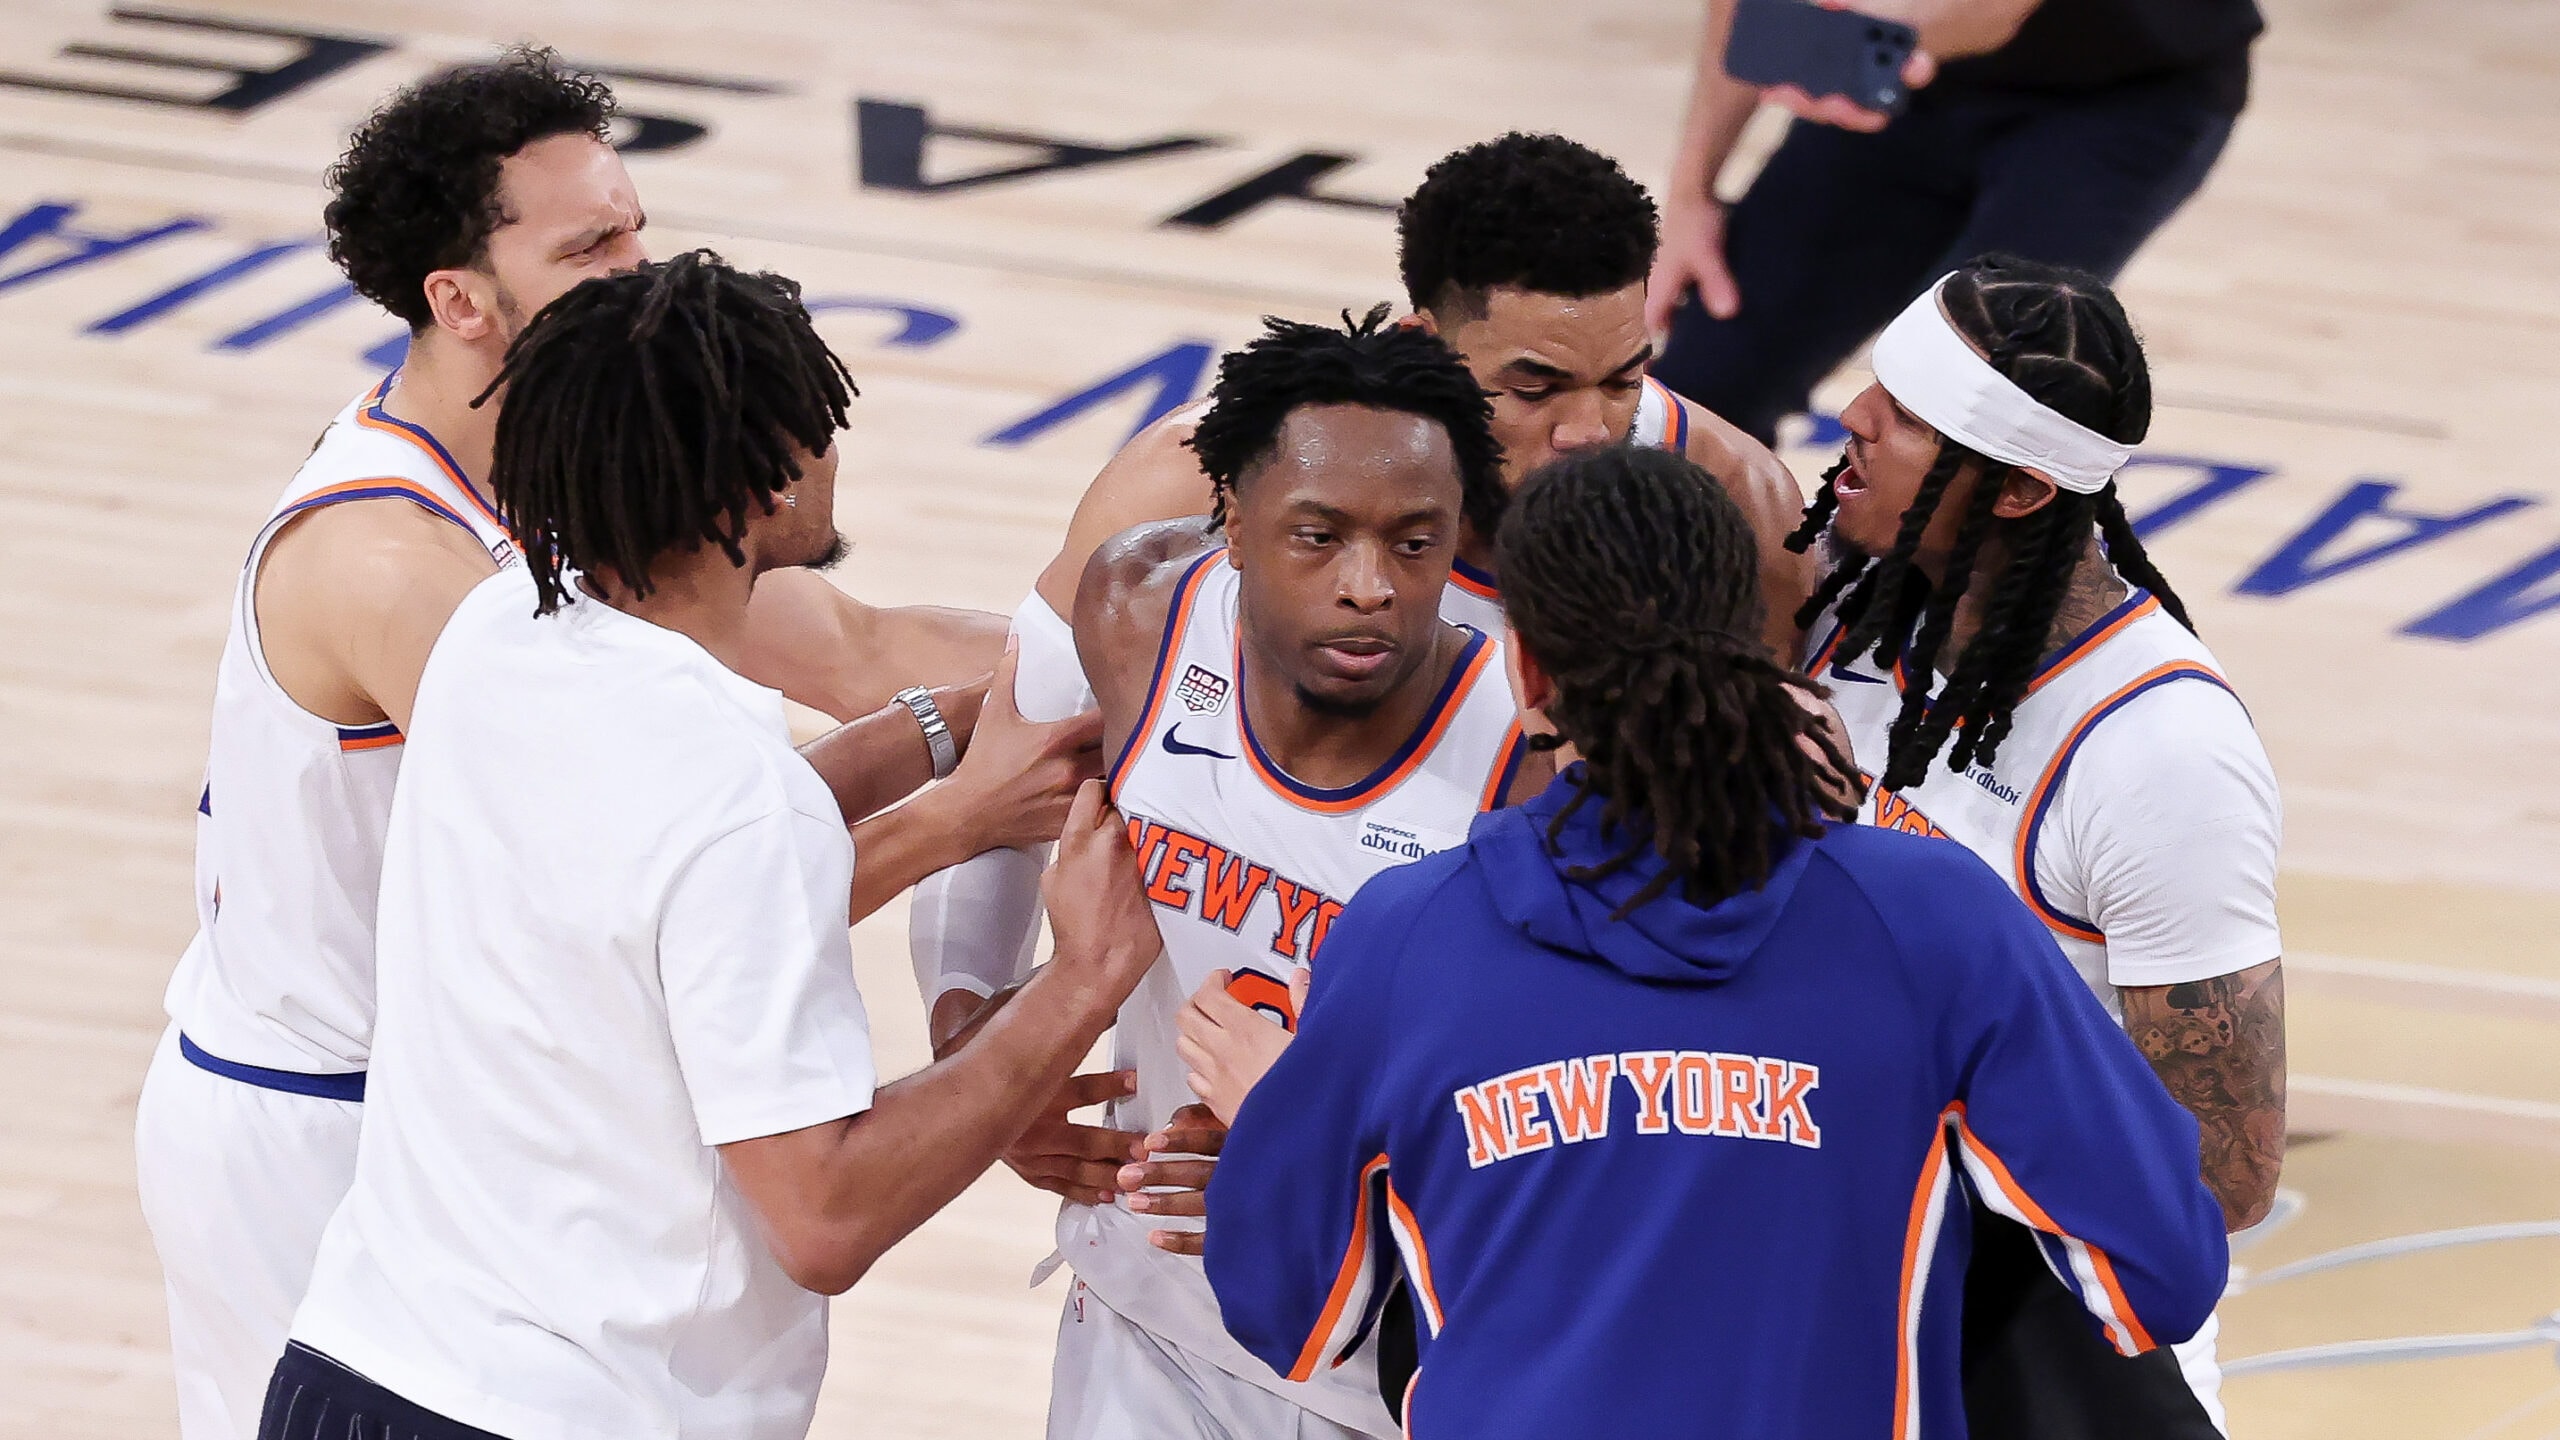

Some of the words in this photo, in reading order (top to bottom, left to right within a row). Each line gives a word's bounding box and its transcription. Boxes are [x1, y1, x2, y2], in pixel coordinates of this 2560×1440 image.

[1186, 667, 1225, 694] USA
[1175, 684, 1220, 713] 250
[1361, 833, 1397, 854] abu
[1366, 822, 1417, 840] experience
[1455, 1054, 1617, 1170] NEW
[1619, 1050, 1821, 1149] YORK
